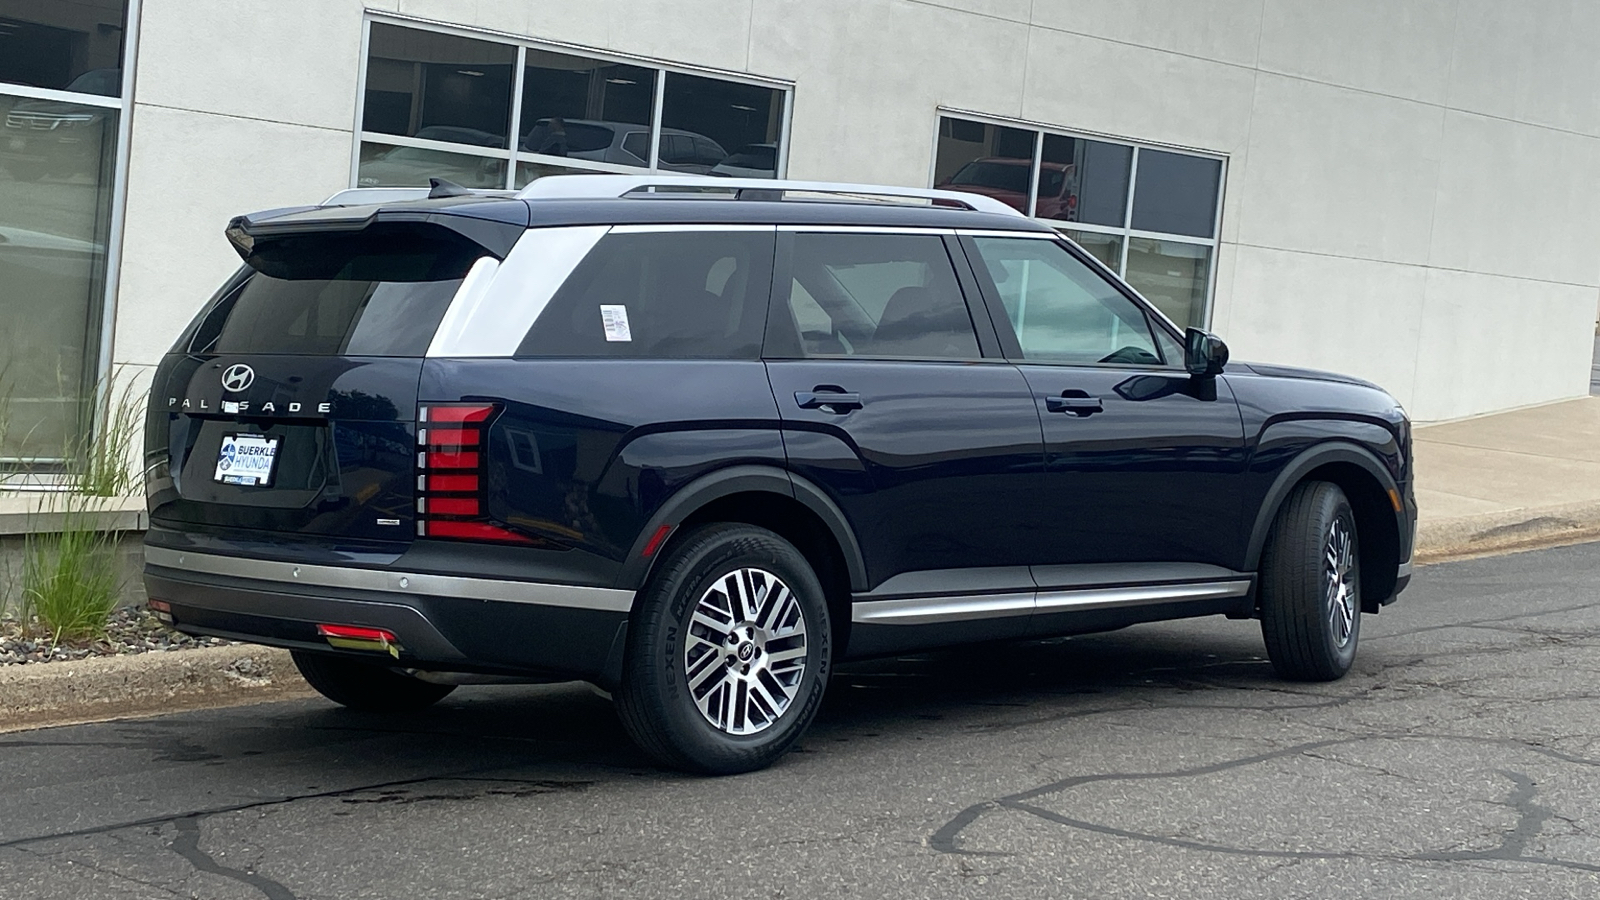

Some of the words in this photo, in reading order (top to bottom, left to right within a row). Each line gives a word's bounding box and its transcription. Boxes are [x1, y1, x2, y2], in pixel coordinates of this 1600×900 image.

[169, 397, 331, 413] PALISADE
[234, 456, 271, 469] HYUNDA
[665, 626, 679, 699] NEXEN
